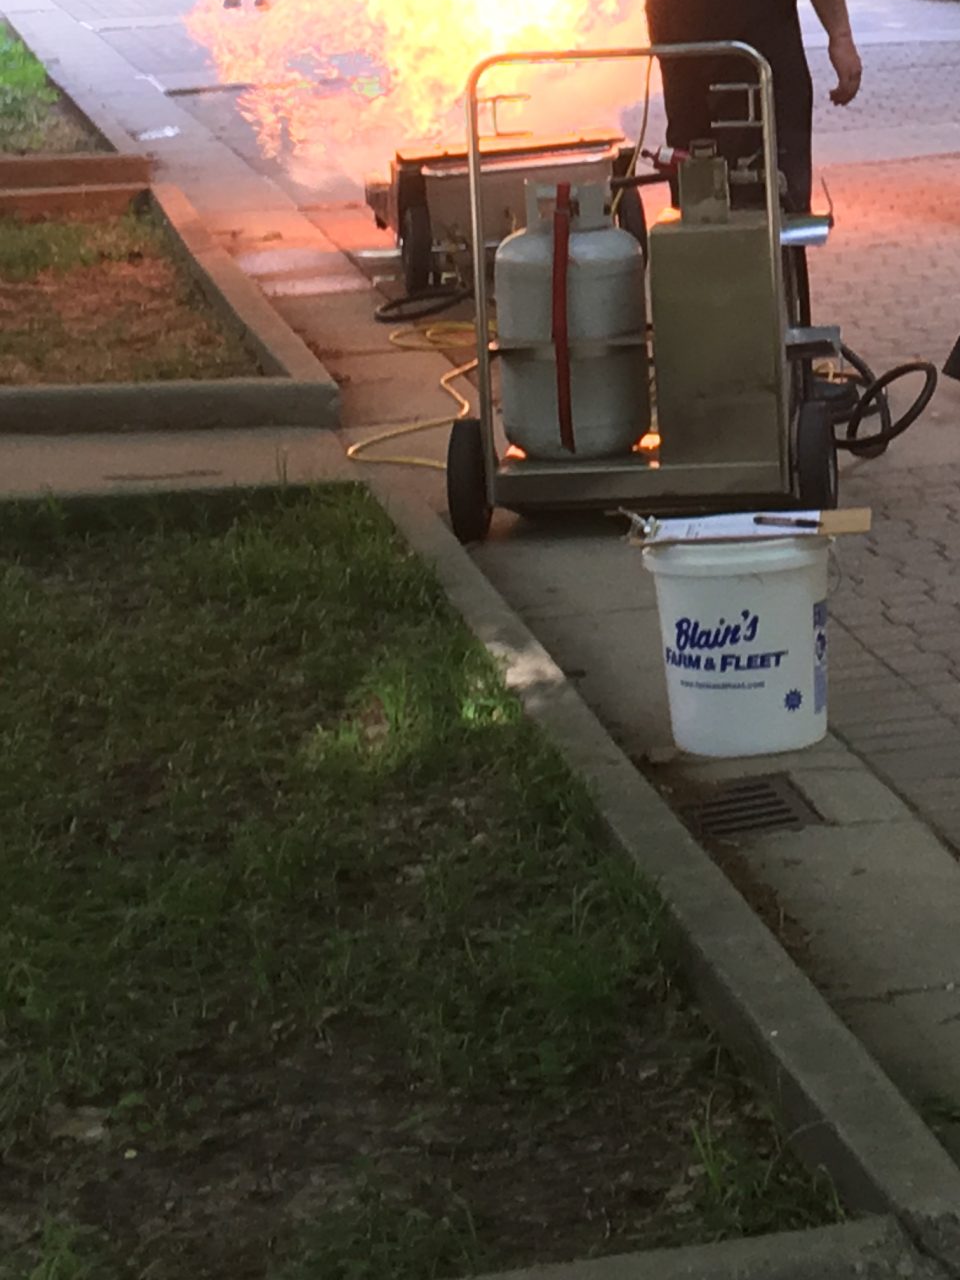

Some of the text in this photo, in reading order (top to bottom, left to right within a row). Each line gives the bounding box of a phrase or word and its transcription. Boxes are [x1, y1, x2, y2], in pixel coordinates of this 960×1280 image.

[675, 609, 759, 651] Blain's
[666, 647, 784, 673] FARM & FLEET
